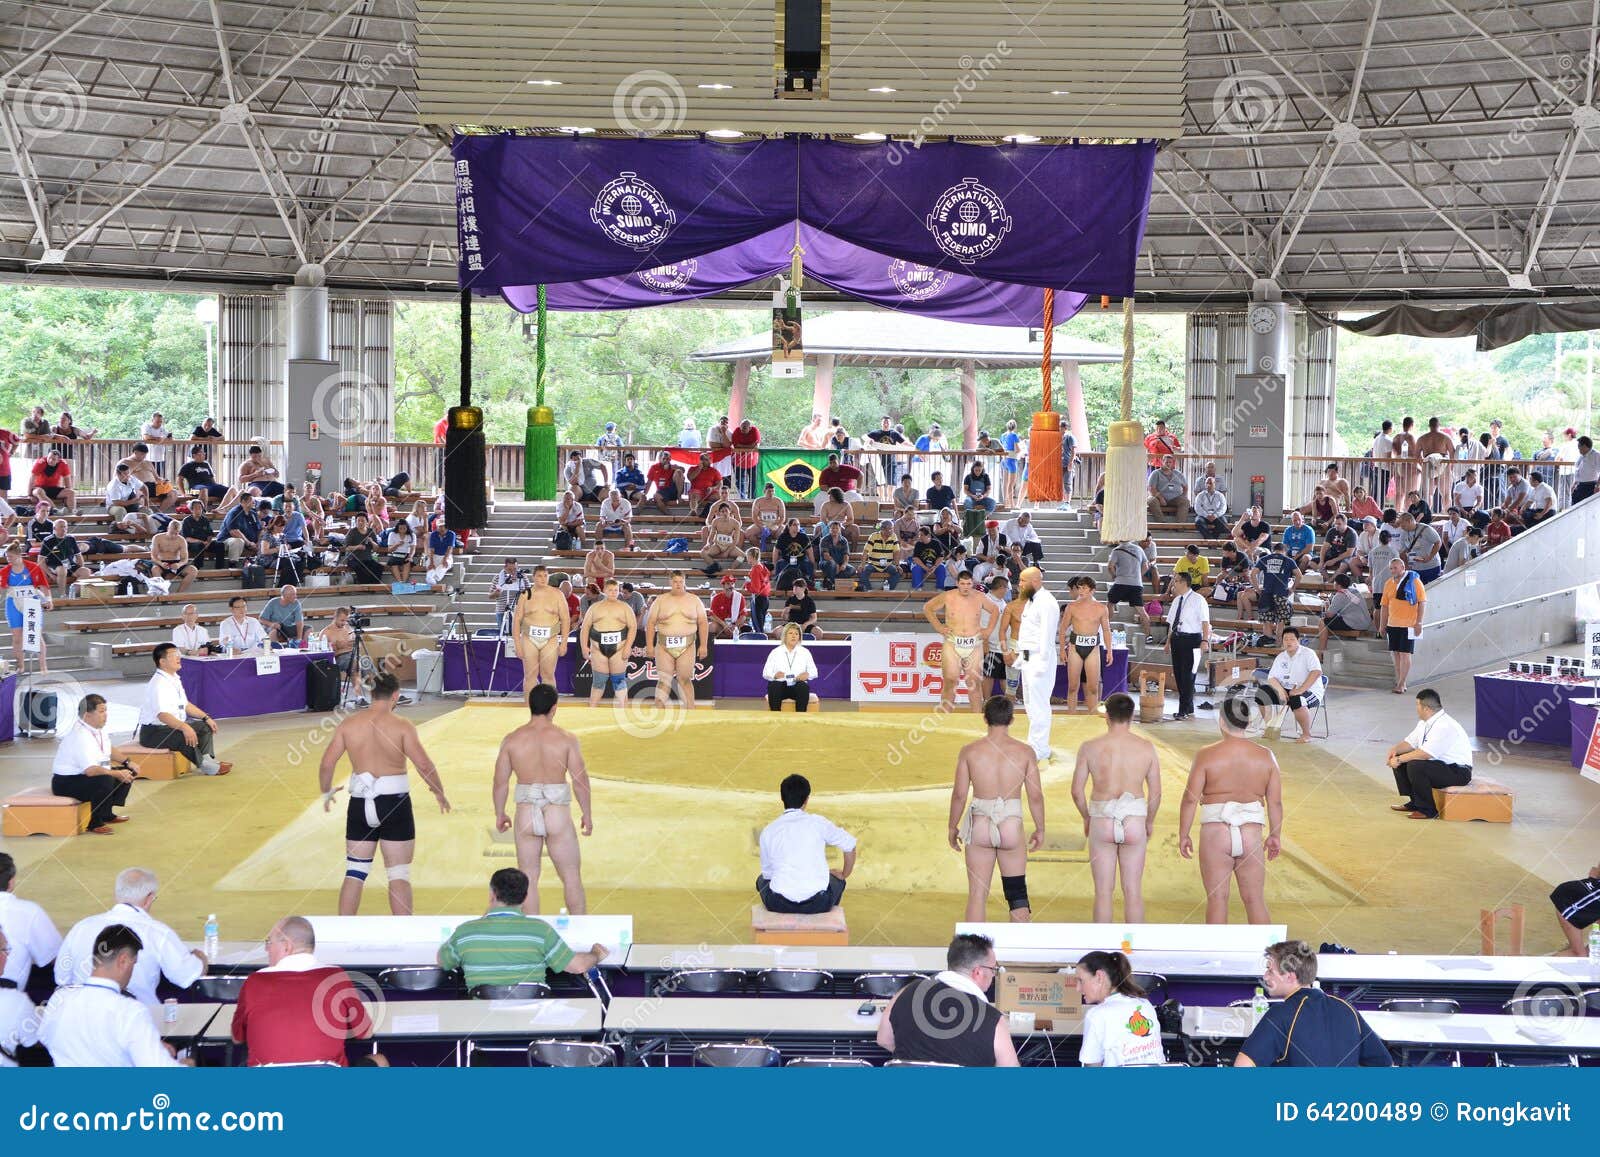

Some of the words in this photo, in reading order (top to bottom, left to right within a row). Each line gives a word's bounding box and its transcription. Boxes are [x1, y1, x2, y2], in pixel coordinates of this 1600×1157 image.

[602, 185, 663, 217] INTERNATIONAL
[939, 190, 1000, 223] INTERNATIONAL
[616, 214, 653, 228] SUMO
[608, 223, 663, 244] FEDERATION
[951, 222, 987, 237] SUMO
[941, 231, 997, 255] FEDERATION
[531, 629, 548, 637] EST
[603, 635, 620, 644] EST
[667, 636, 684, 645] EST
[956, 637, 976, 646] UKR
[1078, 636, 1096, 645] UKR
